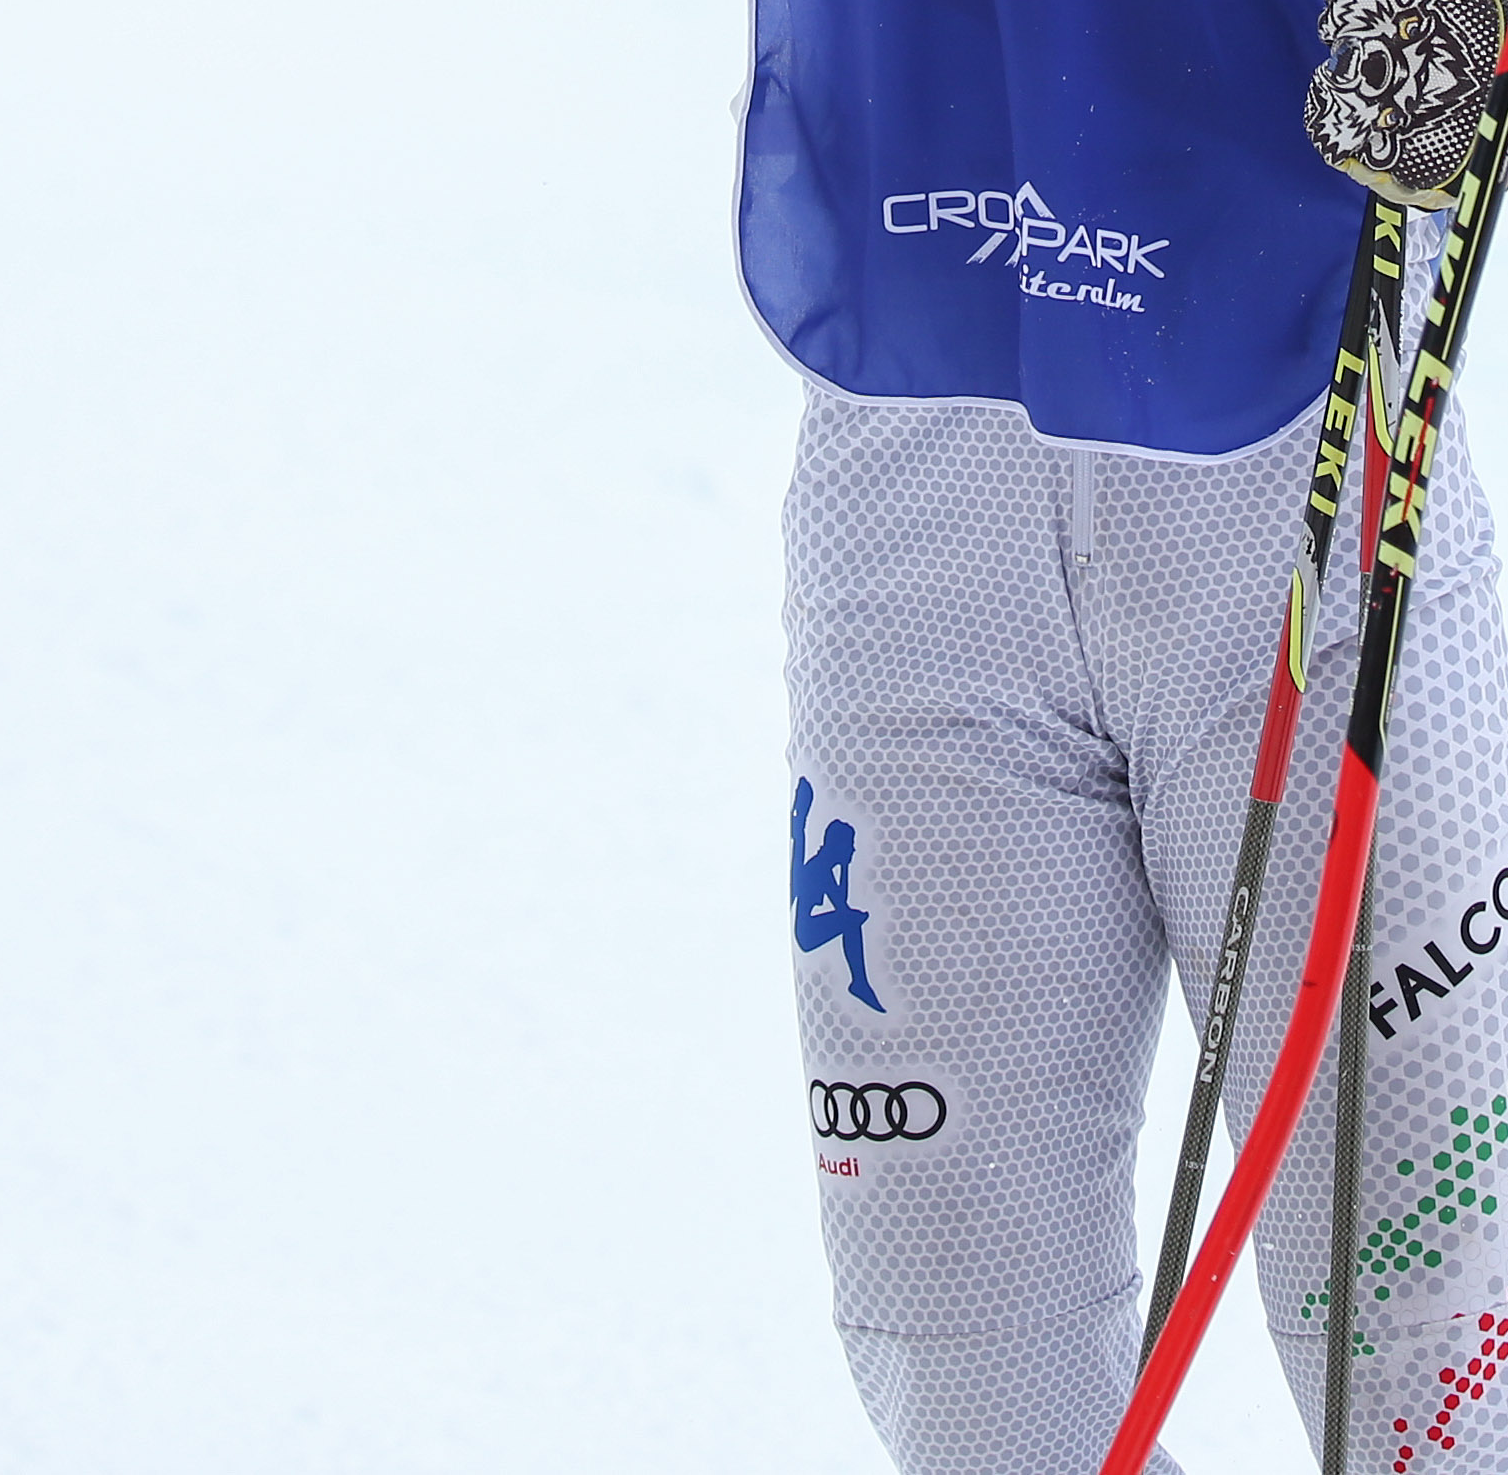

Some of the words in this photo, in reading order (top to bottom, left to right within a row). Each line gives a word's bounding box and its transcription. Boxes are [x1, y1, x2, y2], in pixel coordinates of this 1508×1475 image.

[882, 188, 1171, 279] CROPARK
[1373, 202, 1403, 280] KI
[1019, 264, 1146, 314] iteralm
[1309, 346, 1366, 518] LEKI
[1376, 349, 1453, 580] LEKI
[1199, 885, 1250, 1084] CARBON
[818, 1152, 861, 1178] Audi
